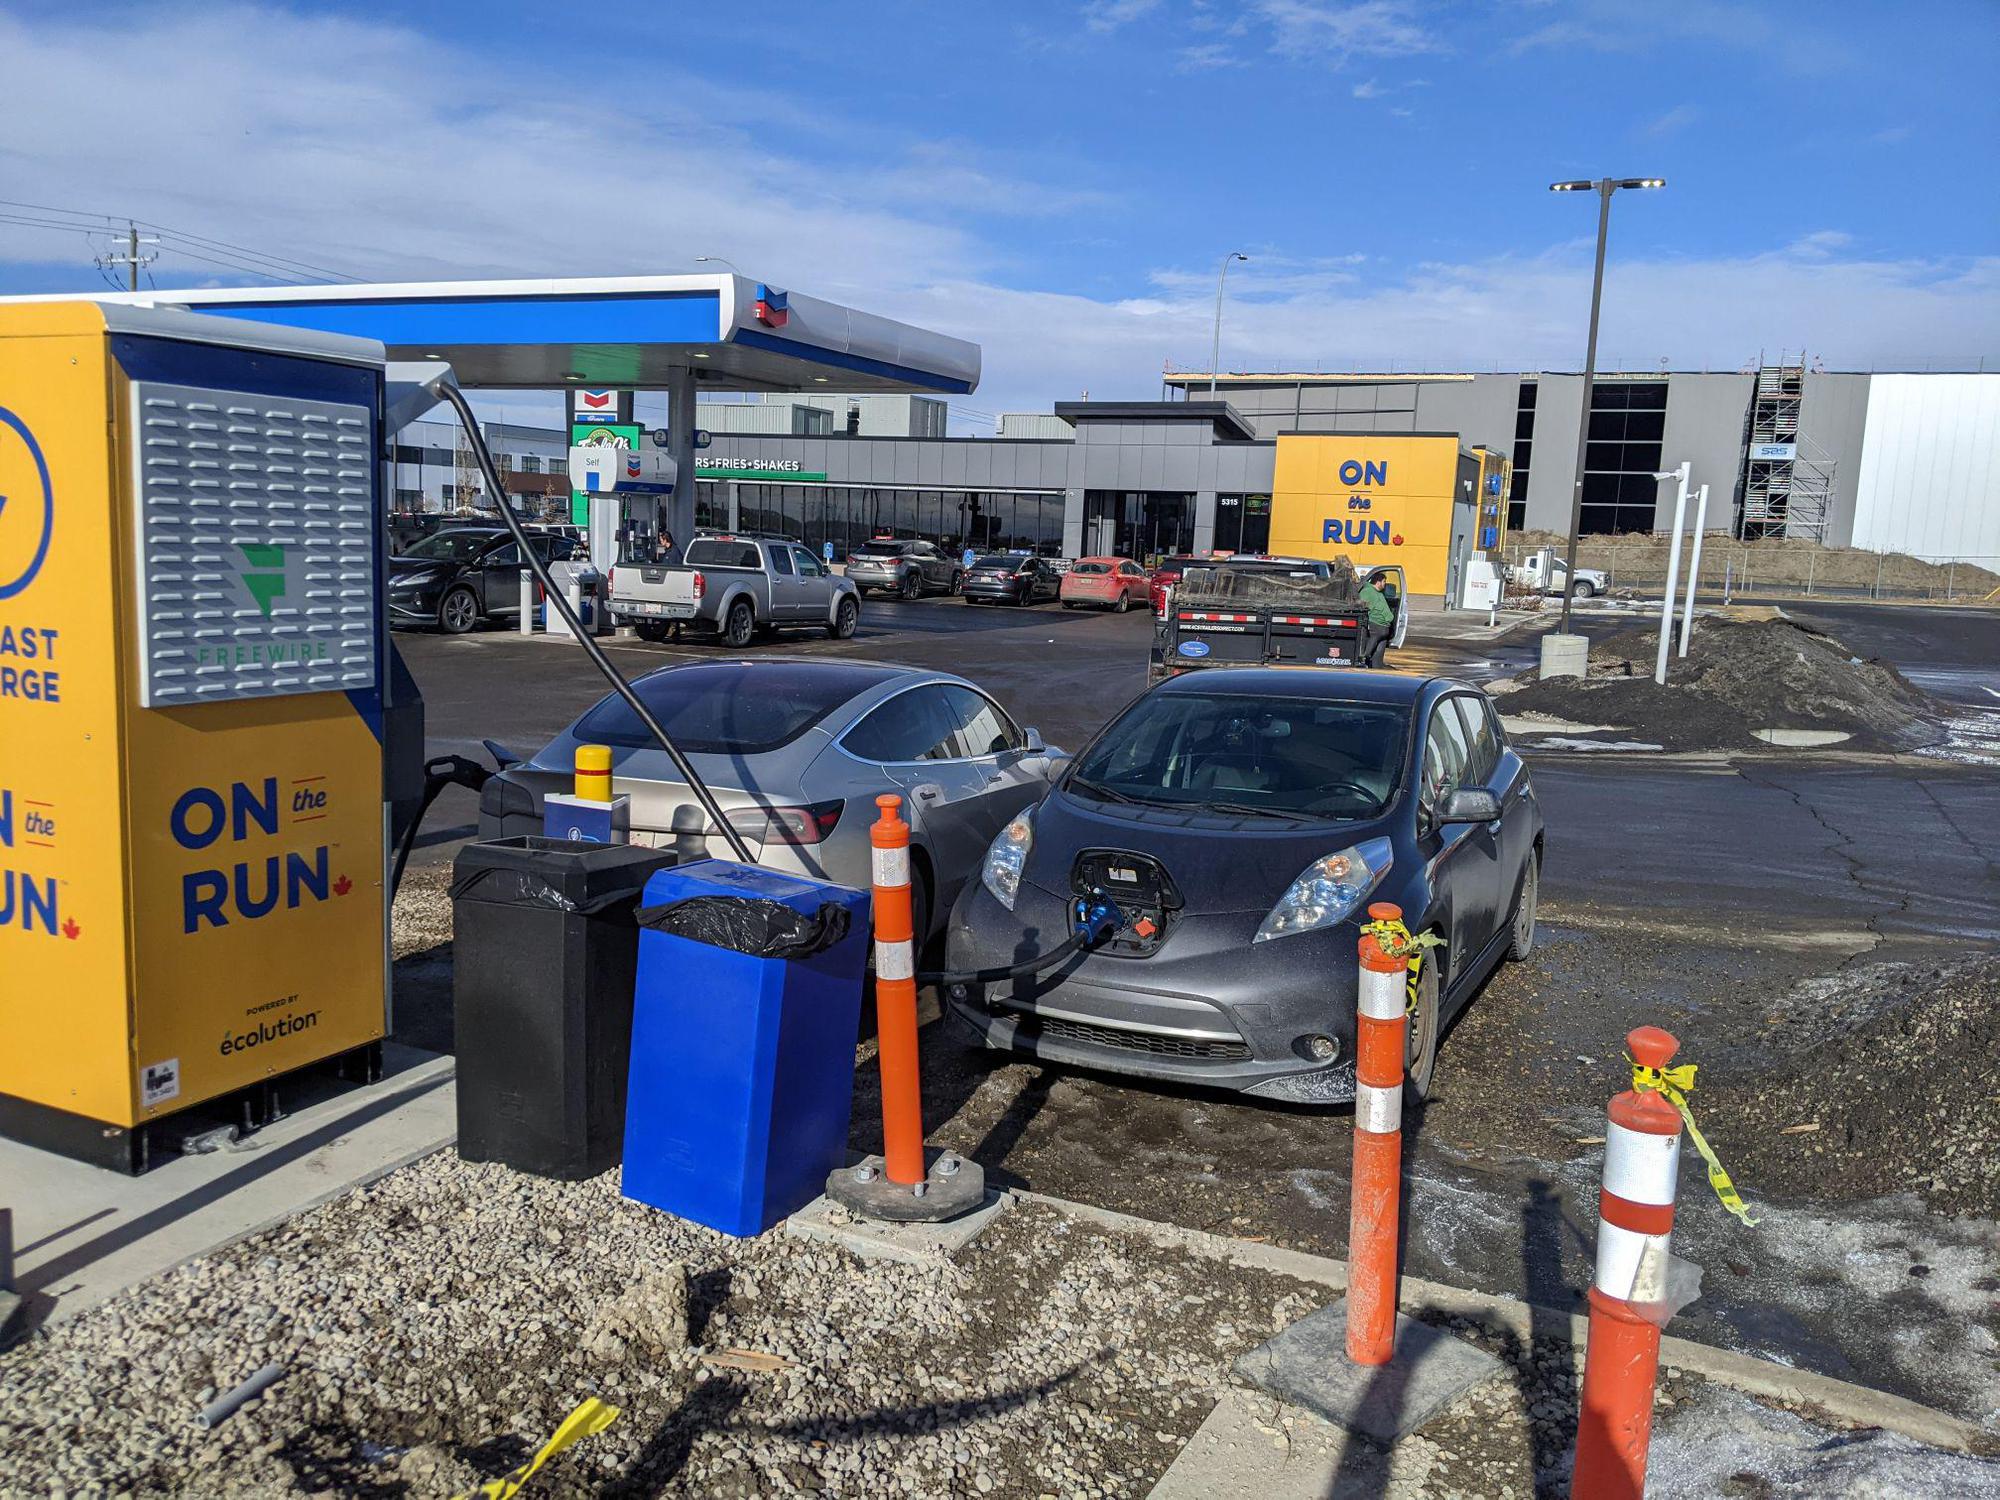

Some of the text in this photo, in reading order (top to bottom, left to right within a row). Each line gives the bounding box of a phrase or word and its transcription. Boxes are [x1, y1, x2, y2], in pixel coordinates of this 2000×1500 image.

[586, 458, 599, 466] Self
[716, 459, 747, 469] FRIES
[753, 460, 799, 471] SHAKES
[1339, 460, 1387, 486] ON
[1348, 496, 1371, 509] the
[1322, 519, 1390, 545] RUN
[0, 625, 58, 660] AST
[198, 641, 327, 665] FREEWIRE
[1, 666, 60, 703] RGE
[25, 811, 55, 836] the
[170, 777, 327, 850] ON the
[183, 845, 329, 934] RUN
[246, 994, 299, 1016] POWERED BY
[220, 1012, 317, 1056] écolution
